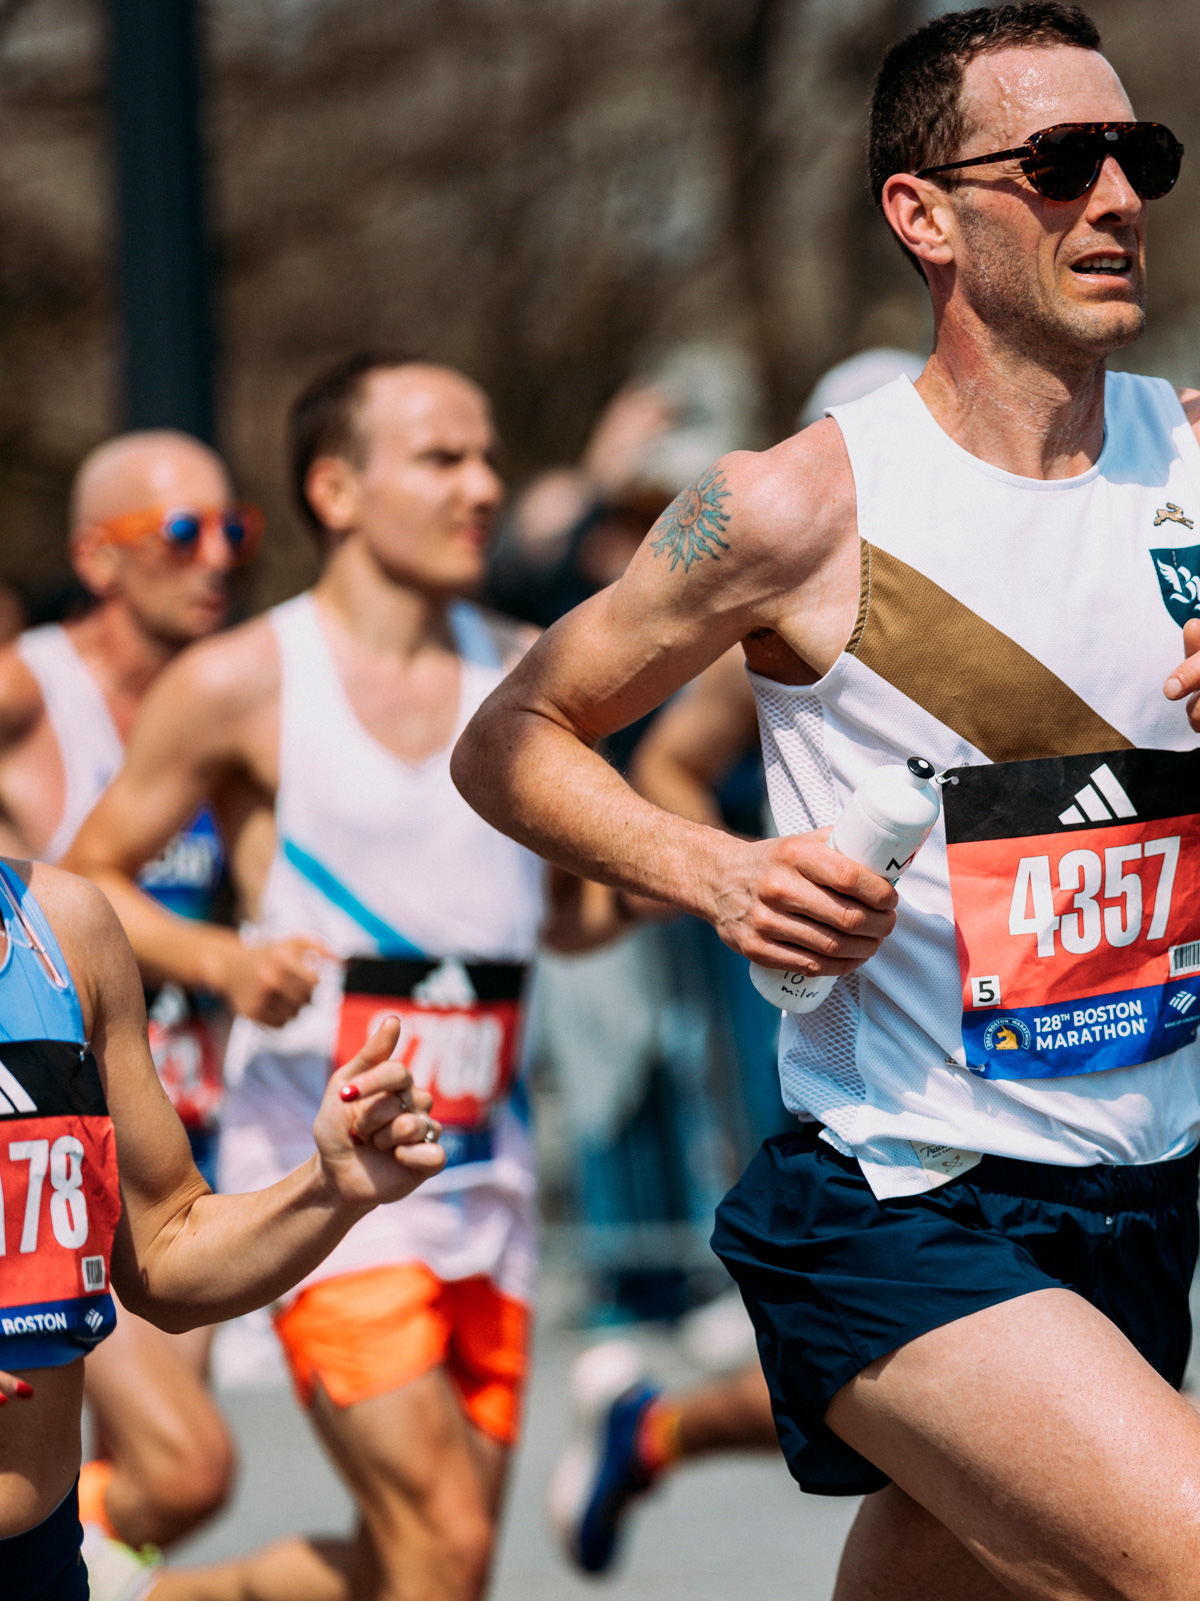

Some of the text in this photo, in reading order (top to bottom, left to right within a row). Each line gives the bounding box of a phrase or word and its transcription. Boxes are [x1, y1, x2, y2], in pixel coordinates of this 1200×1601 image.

[1008, 835, 1182, 958] 4357
[784, 970, 804, 984] 10
[977, 979, 996, 1003] 5
[988, 1019, 1009, 1032] BOSTON
[1033, 999, 1143, 1033] 128TH BOSTON
[0, 1135, 88, 1256] 78
[2, 1311, 68, 1336] BOSTON
